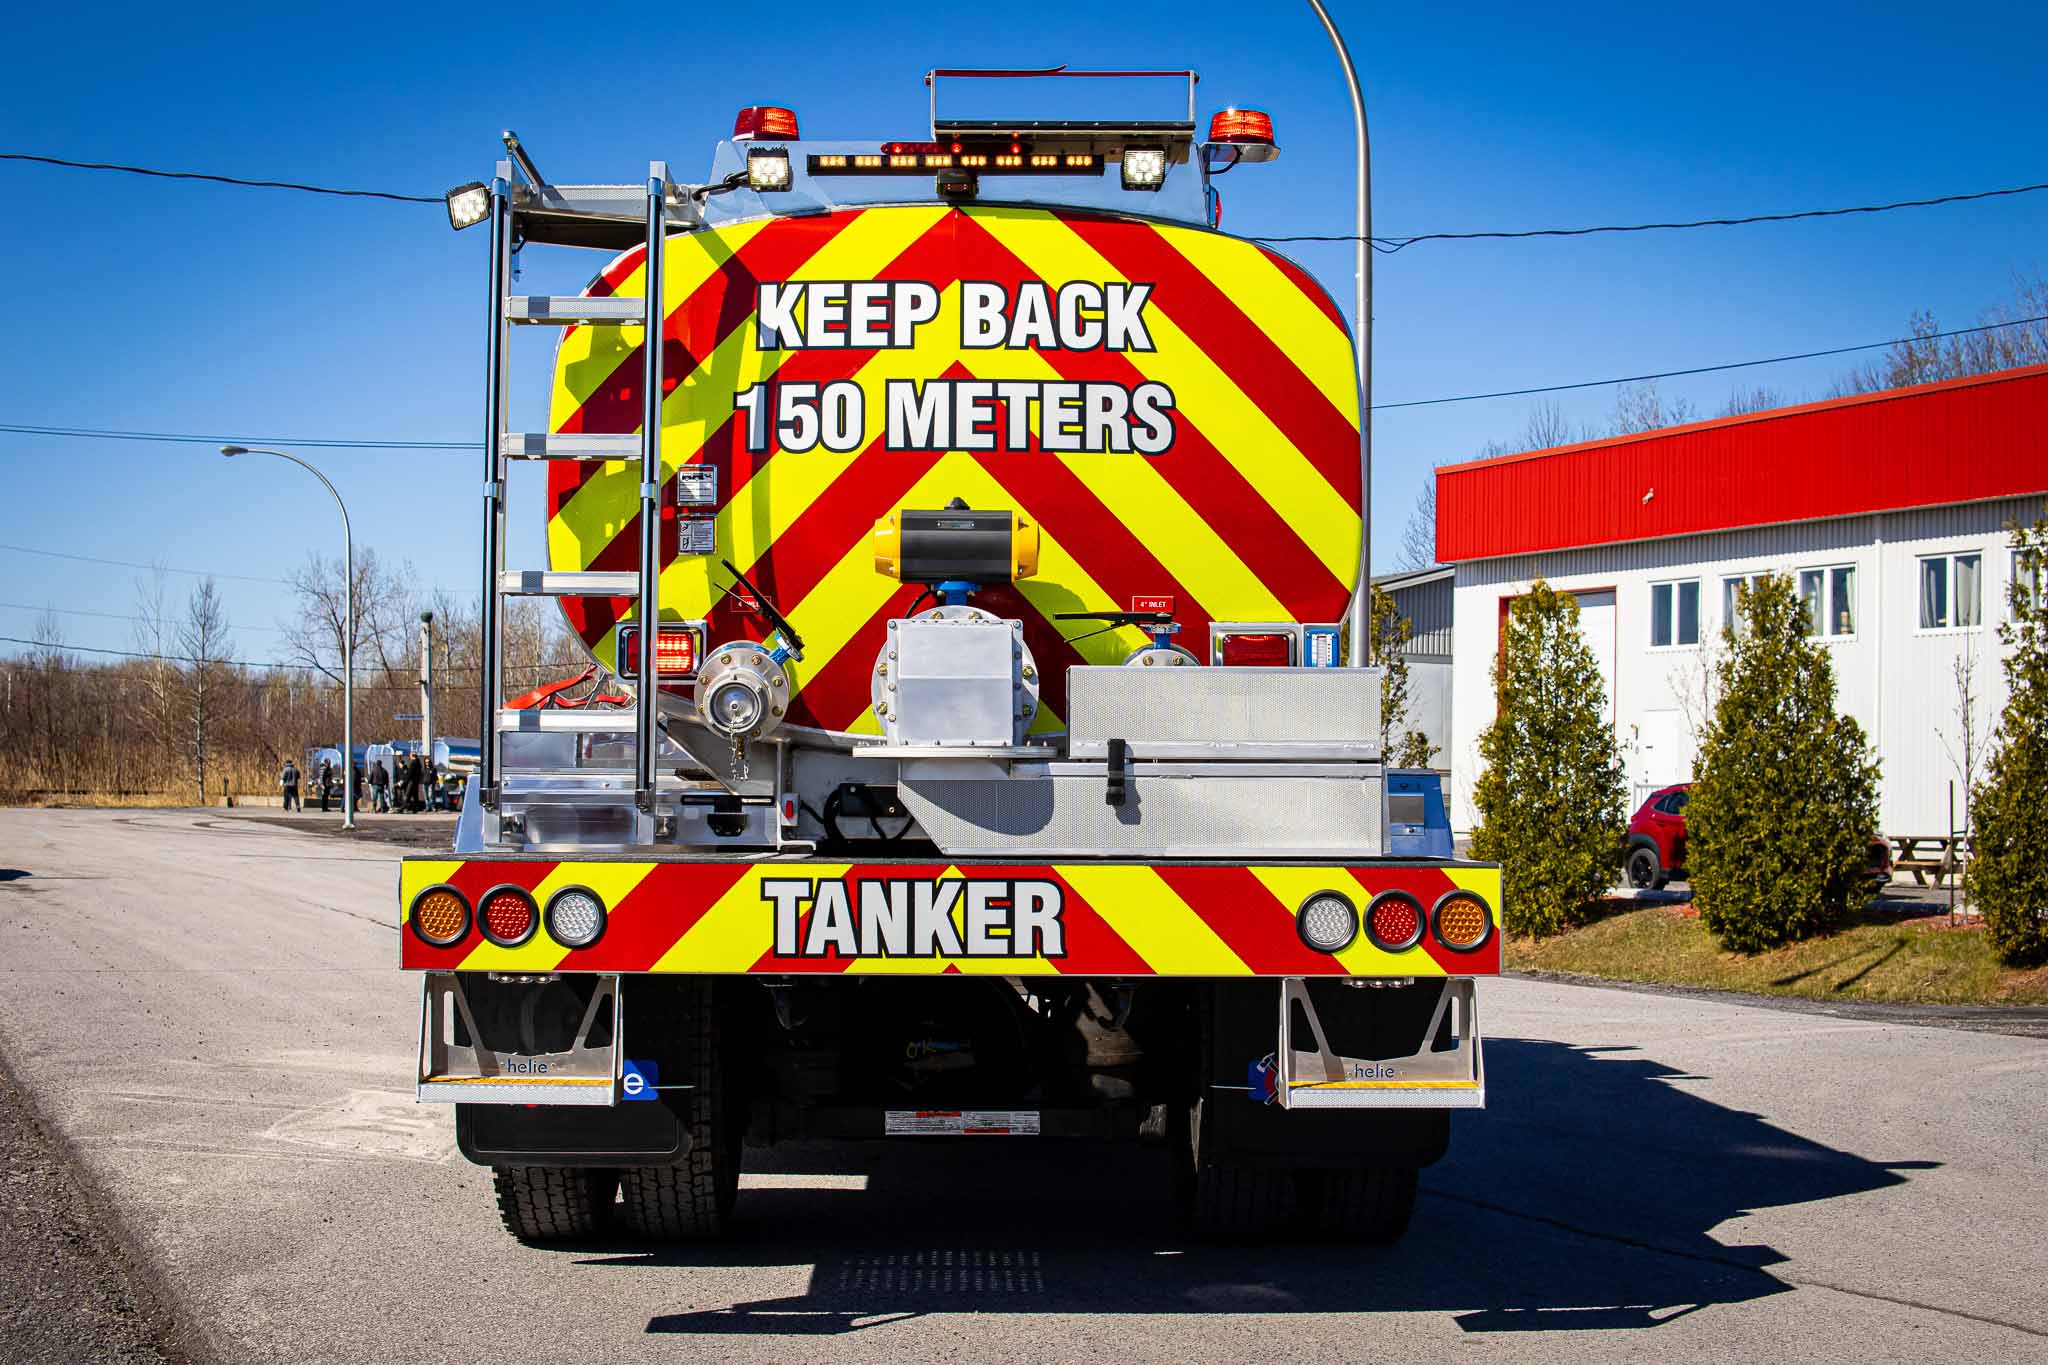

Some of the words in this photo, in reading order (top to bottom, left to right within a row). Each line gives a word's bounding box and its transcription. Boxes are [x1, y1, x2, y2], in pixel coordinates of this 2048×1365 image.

[756, 280, 940, 351] KEEP
[960, 280, 1157, 352] BACK
[734, 379, 865, 453] 150
[885, 379, 1176, 454] METERS
[761, 877, 1067, 958] TANKER
[508, 1058, 548, 1073] helie
[1355, 1063, 1394, 1078] helie
